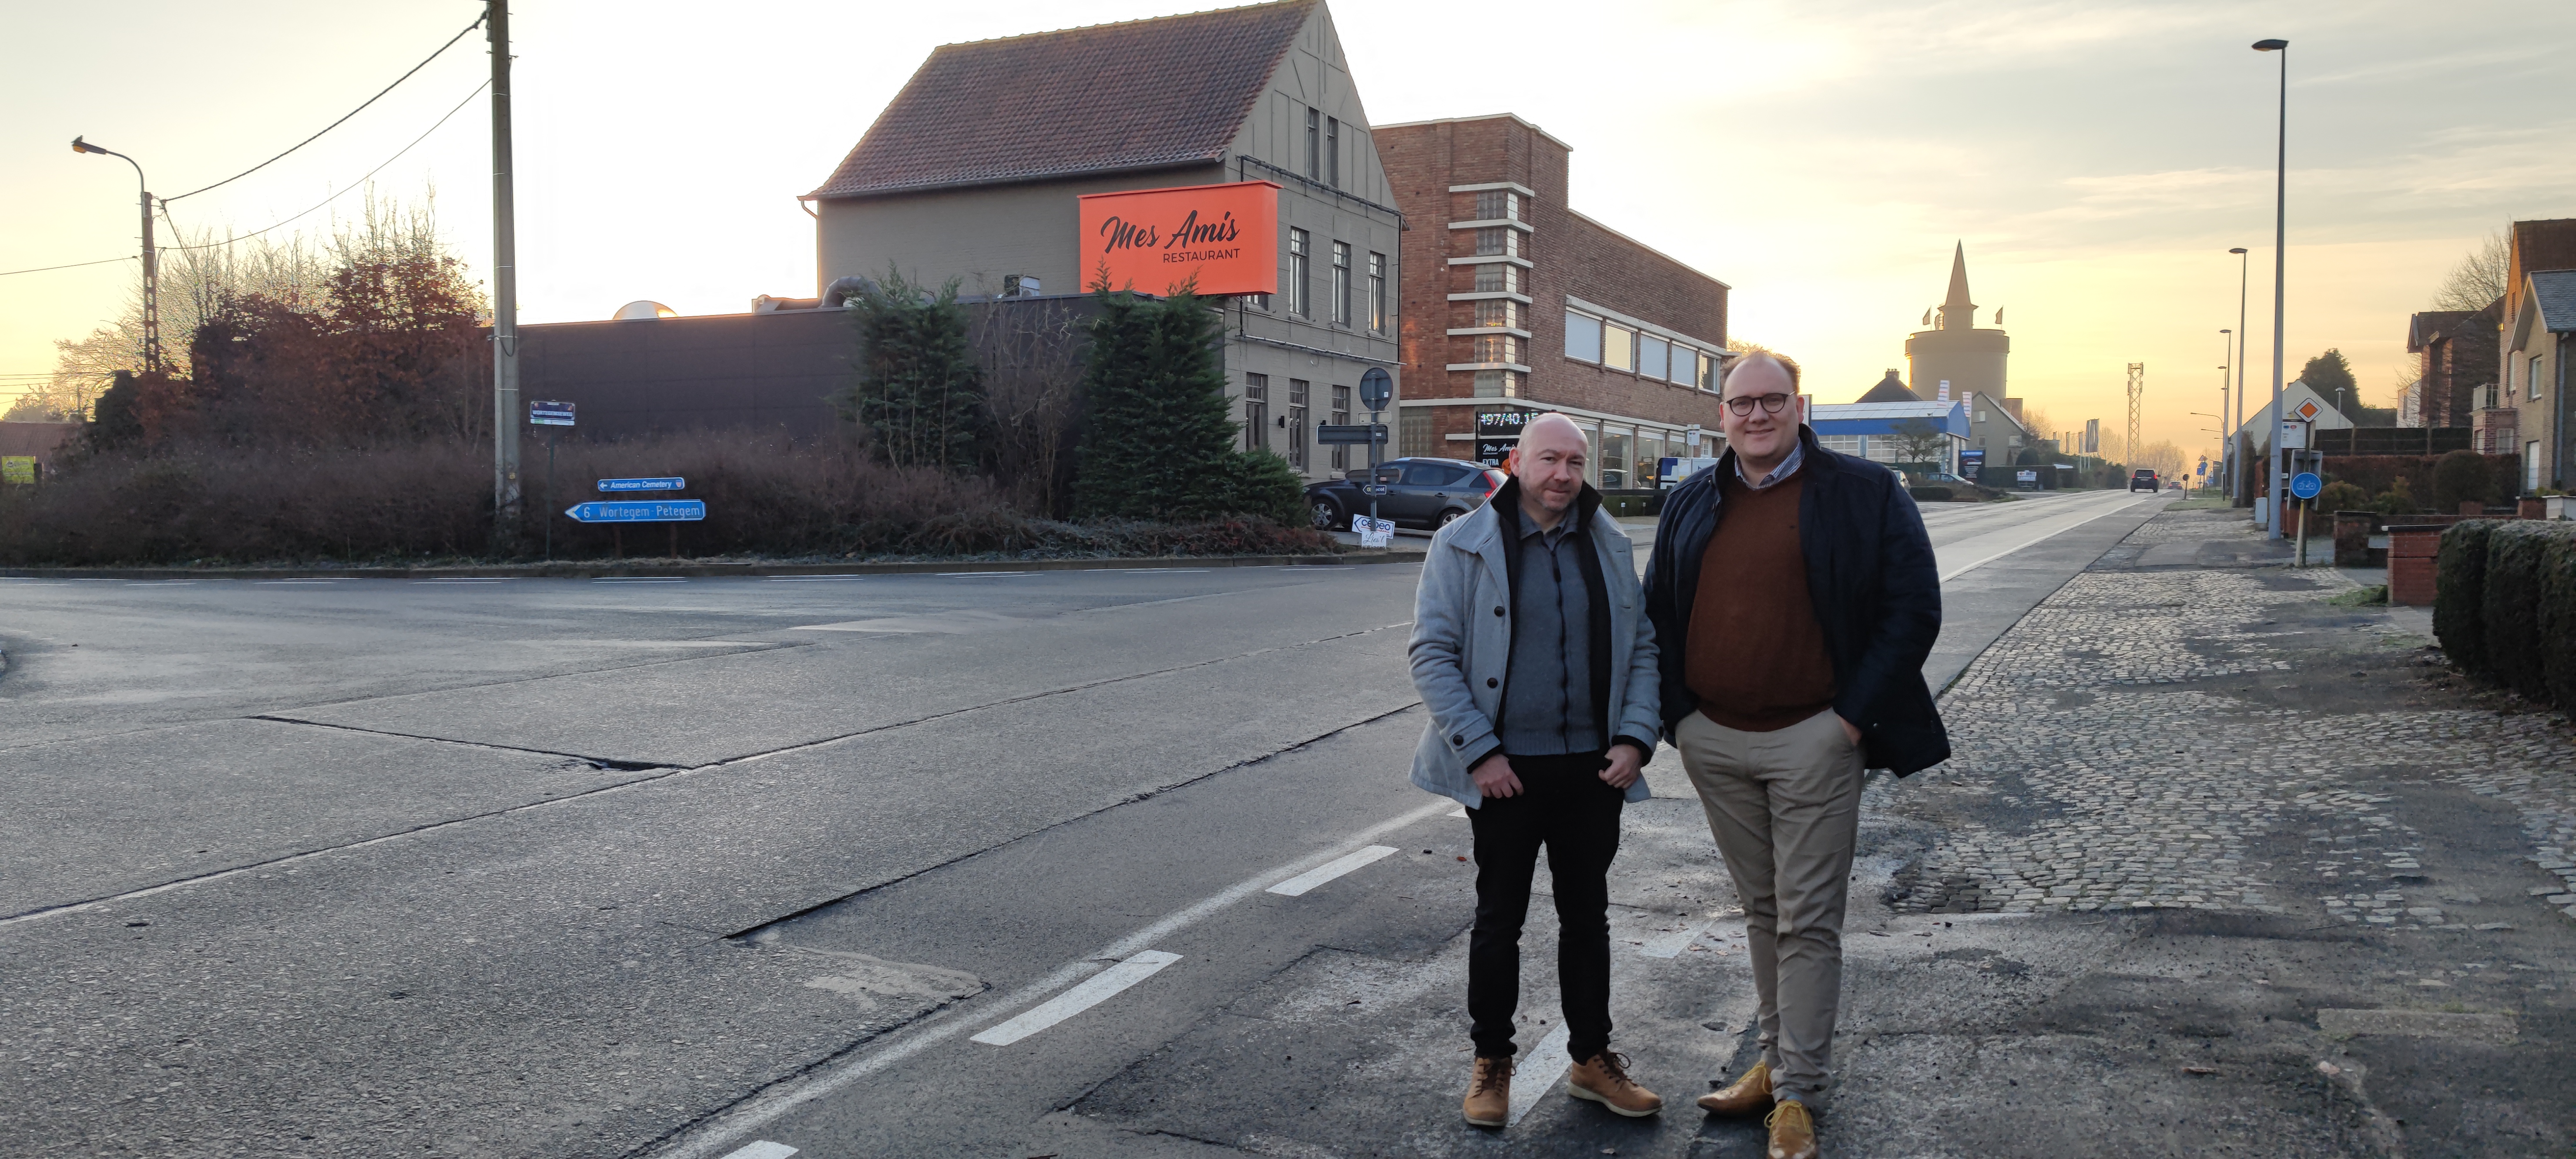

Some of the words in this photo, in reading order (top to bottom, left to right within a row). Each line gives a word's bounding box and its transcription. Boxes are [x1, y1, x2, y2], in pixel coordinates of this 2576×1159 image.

[1100, 216, 1159, 254] Mes
[1164, 210, 1240, 249] Amis
[1163, 248, 1241, 263] RESTAURANT
[1483, 443, 1498, 452] Mes
[641, 481, 672, 489] Cemetery
[584, 507, 590, 518] 6
